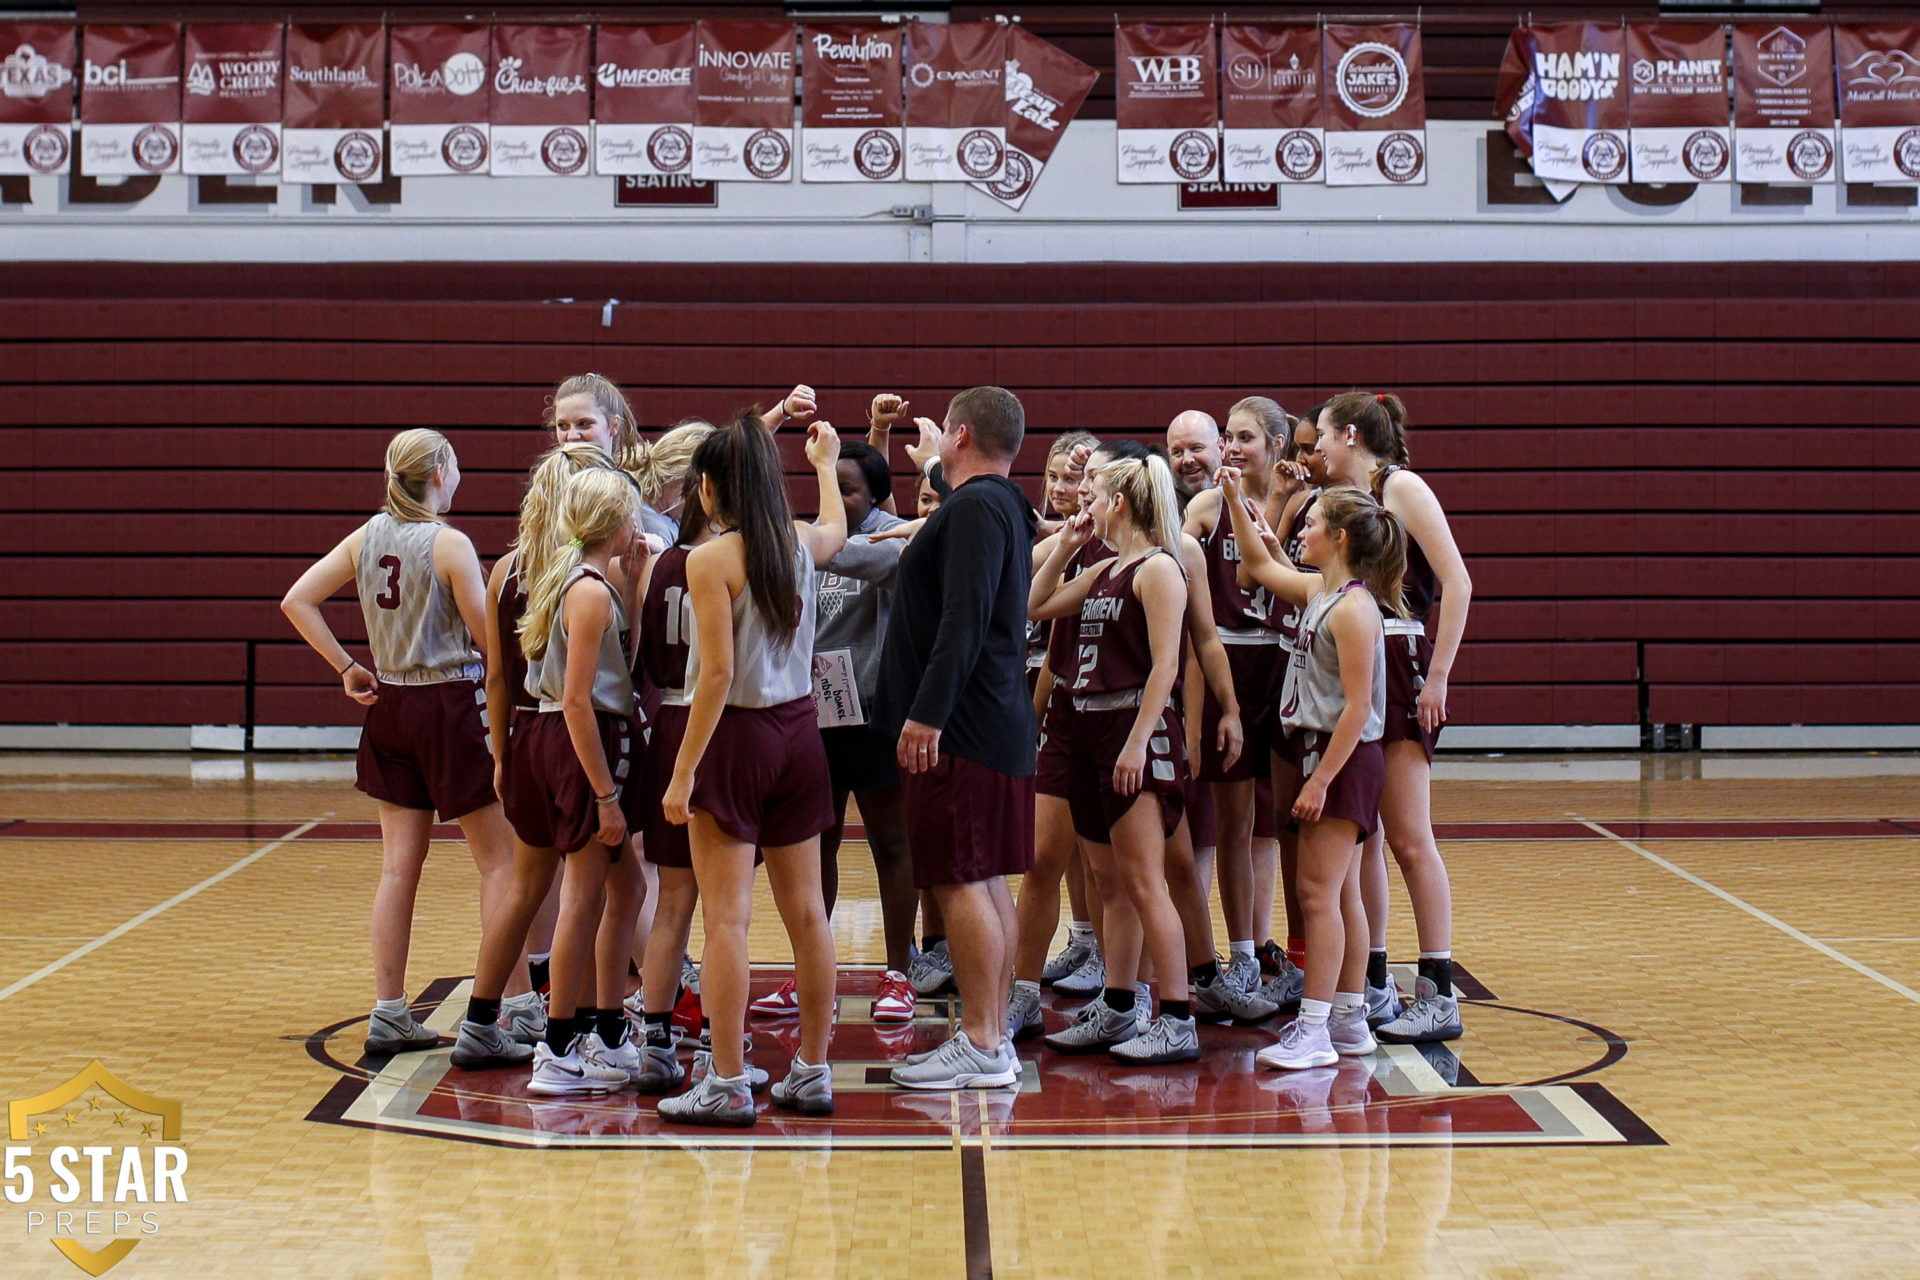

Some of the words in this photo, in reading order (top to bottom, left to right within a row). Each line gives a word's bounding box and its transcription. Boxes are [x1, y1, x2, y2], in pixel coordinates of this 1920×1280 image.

[813, 33, 892, 62] Revolution
[219, 61, 279, 75] WOODY
[289, 65, 366, 82] Southland
[1131, 57, 1201, 82] WHB
[1535, 51, 1621, 78] HAM'N
[1656, 60, 1722, 75] PLANET
[220, 75, 276, 89] CREEK
[936, 69, 1001, 81] EMINENT
[376, 554, 401, 611] 3
[1081, 597, 1123, 621] EARDEN
